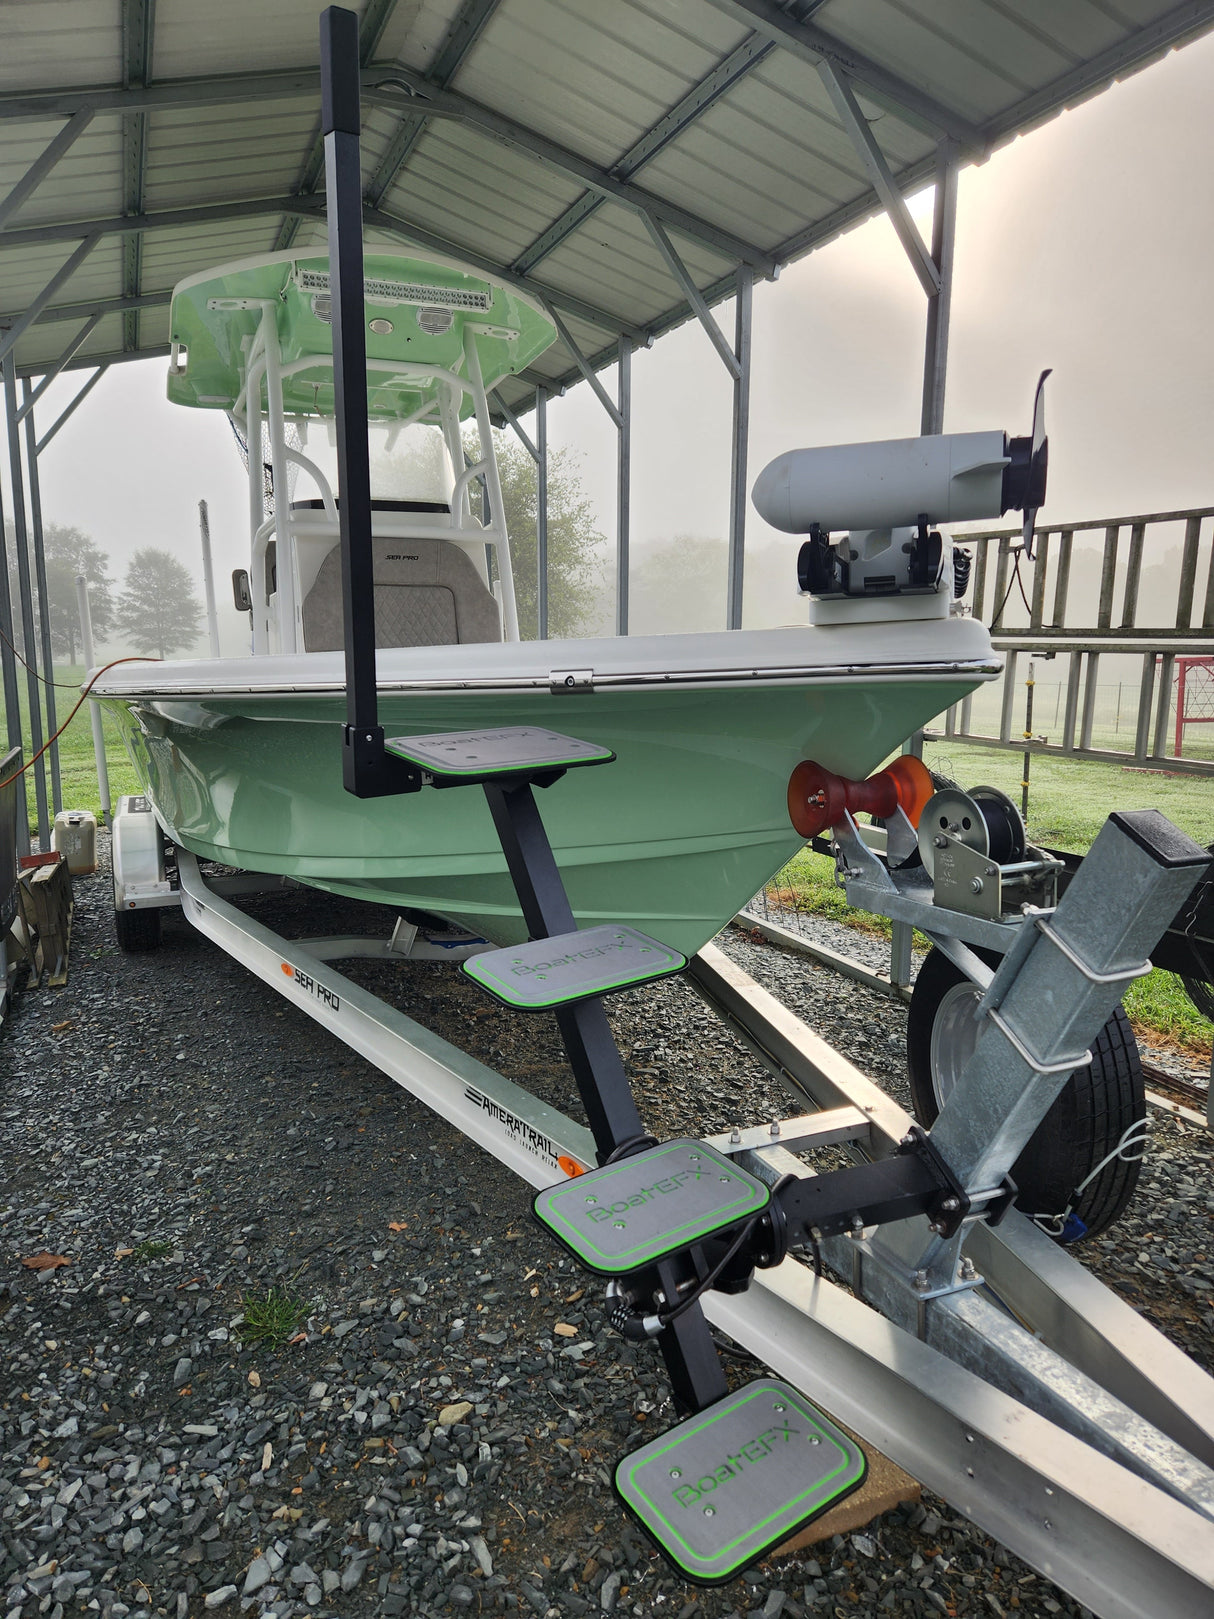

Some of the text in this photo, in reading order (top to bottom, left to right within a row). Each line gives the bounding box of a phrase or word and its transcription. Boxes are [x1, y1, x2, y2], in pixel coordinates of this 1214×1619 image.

[511, 940, 633, 976] BoatEFX
[294, 967, 340, 1012] SEA PRO
[481, 1093, 559, 1162] AMERATRAIL
[586, 1164, 711, 1223] BoatEFX
[672, 1419, 800, 1509] BoatEFX
